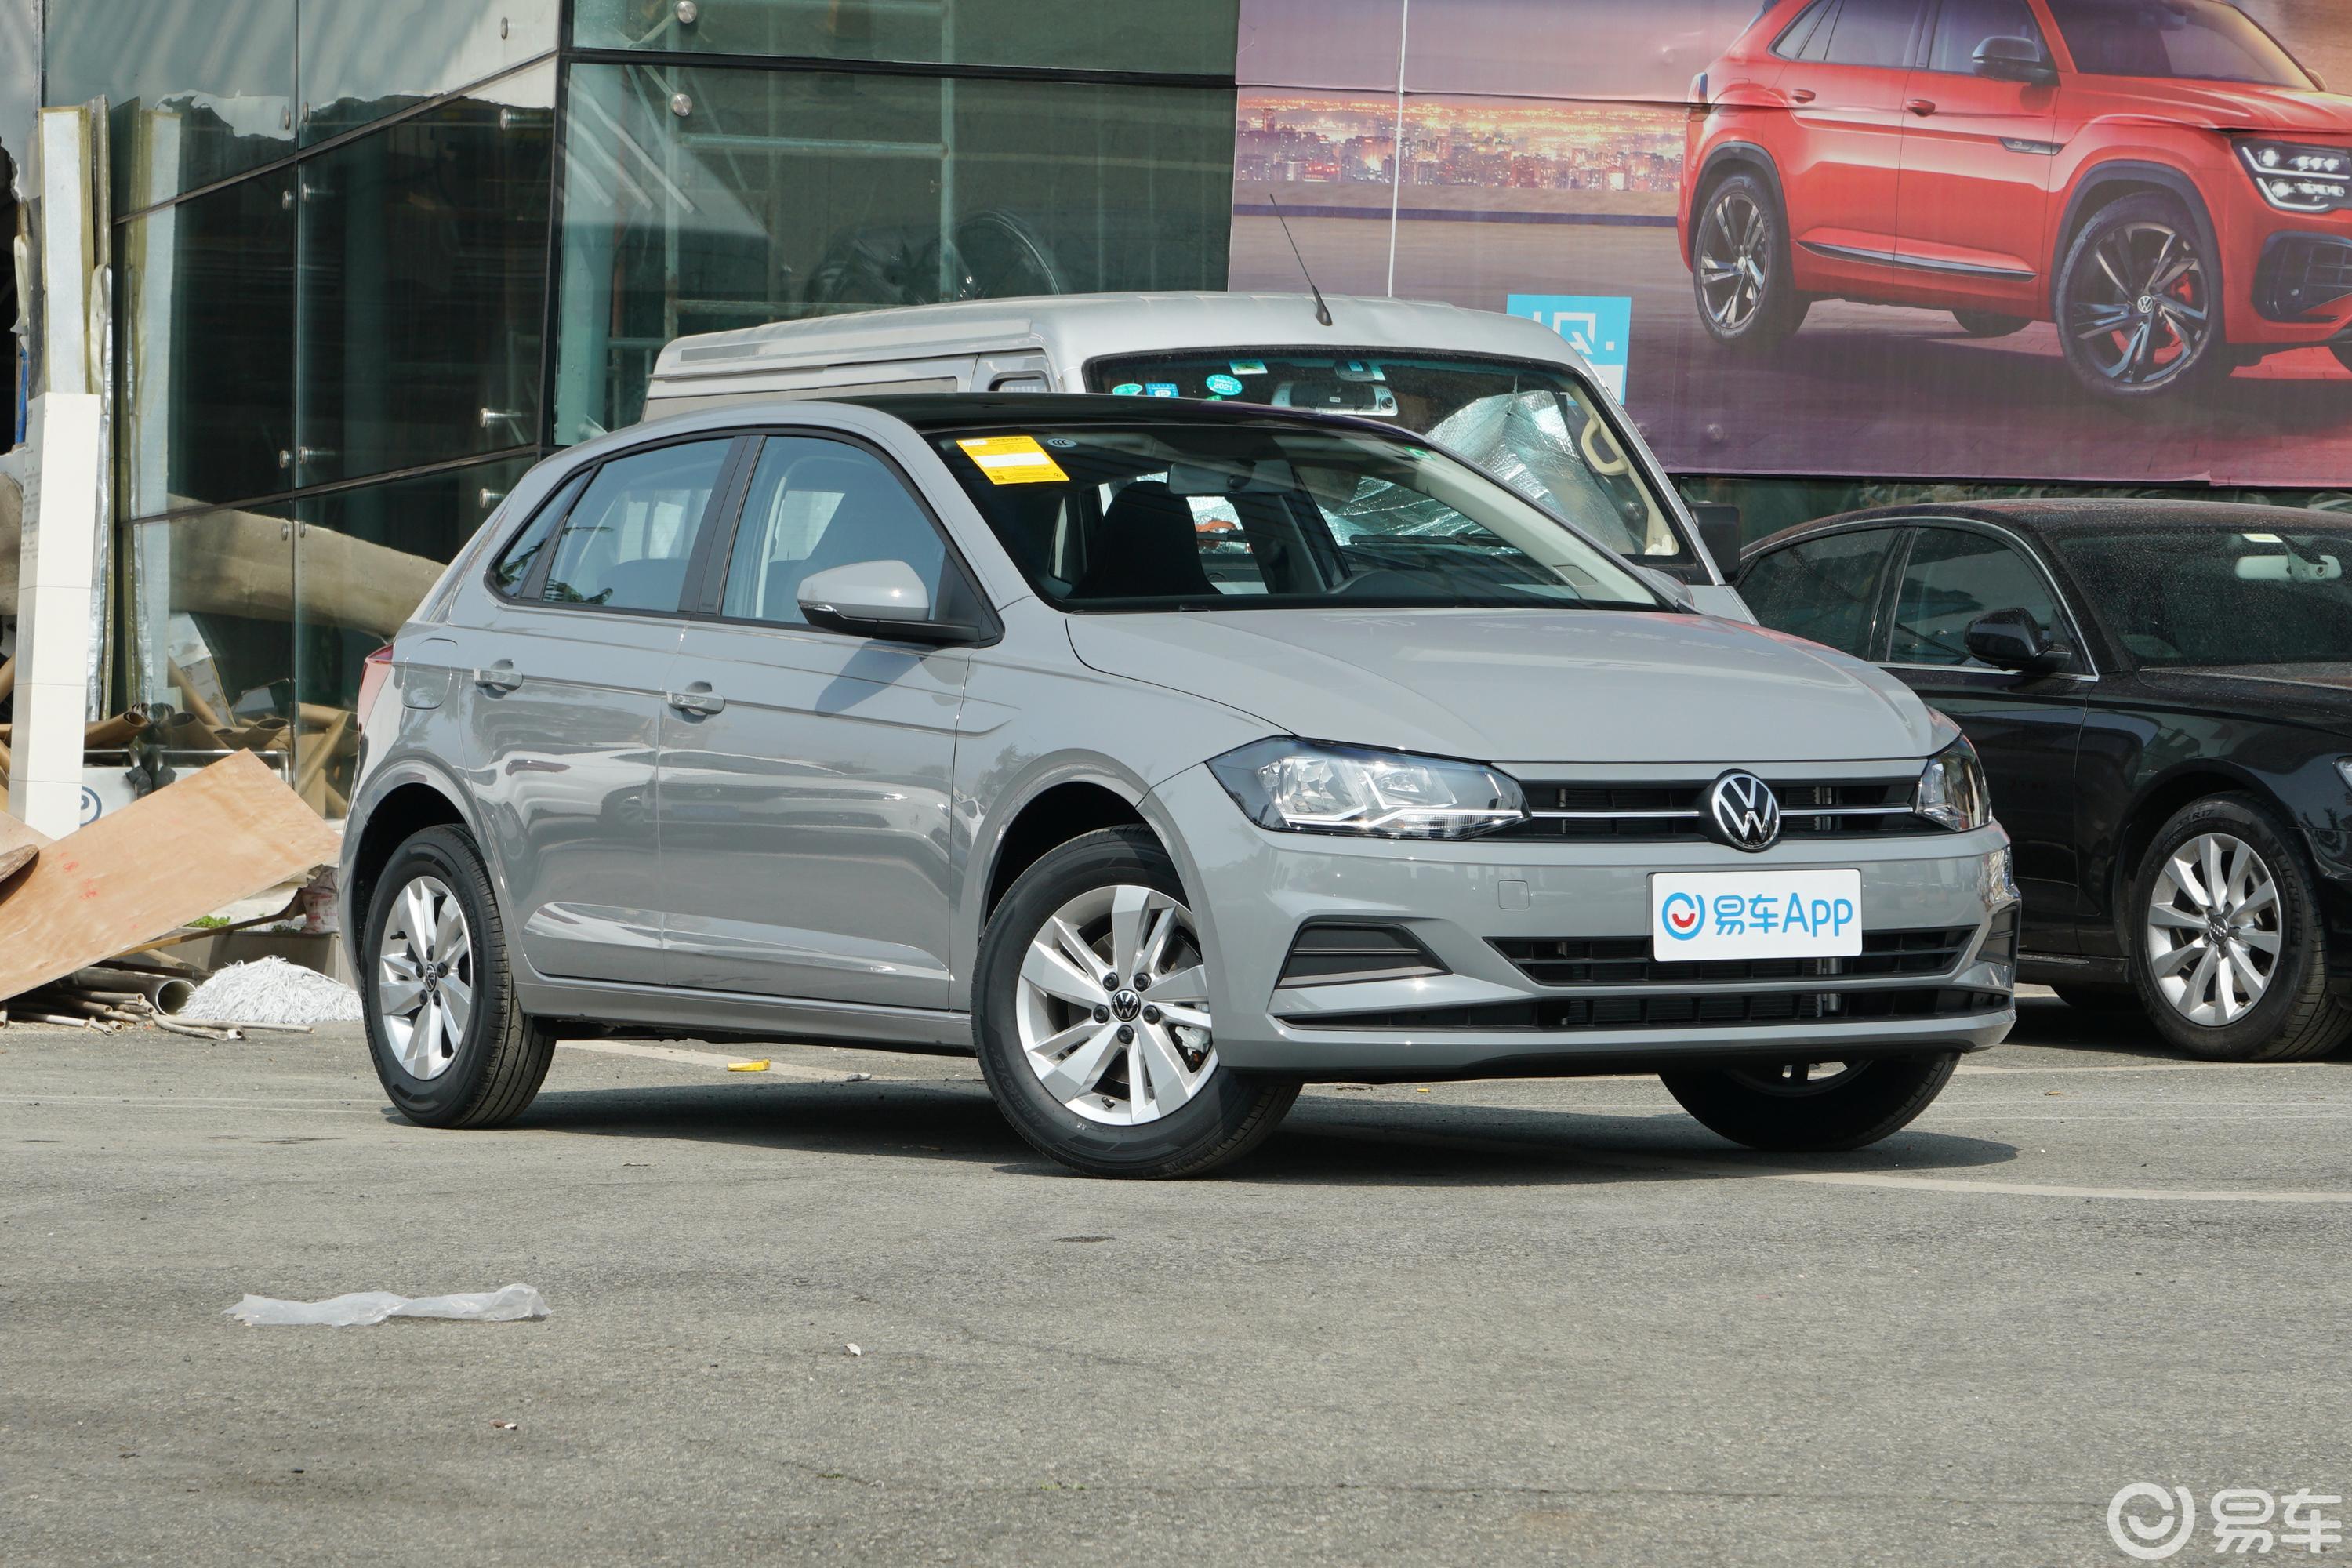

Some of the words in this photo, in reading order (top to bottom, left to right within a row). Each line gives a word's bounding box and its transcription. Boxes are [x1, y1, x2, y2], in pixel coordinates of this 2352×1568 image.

[1214, 382, 1233, 391] 2021
[1712, 773, 1780, 848] VW
[1713, 892, 1853, 937] 易车App
